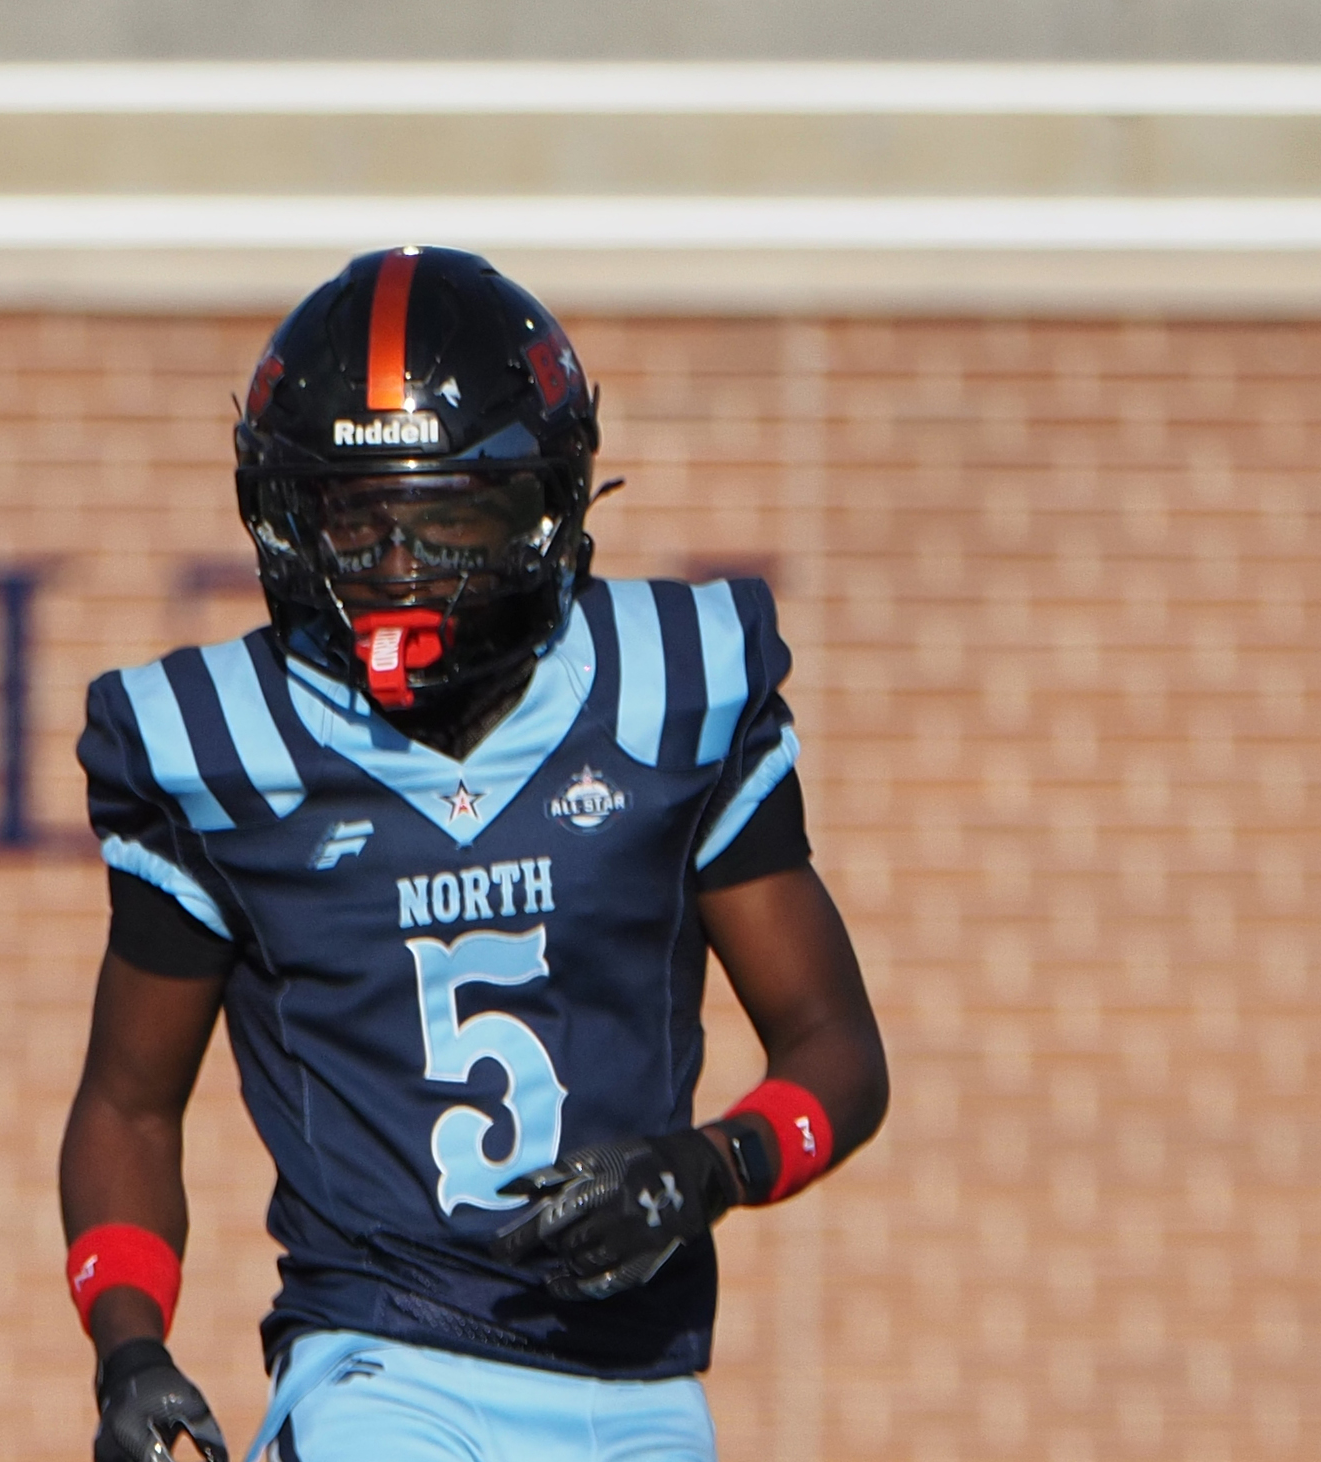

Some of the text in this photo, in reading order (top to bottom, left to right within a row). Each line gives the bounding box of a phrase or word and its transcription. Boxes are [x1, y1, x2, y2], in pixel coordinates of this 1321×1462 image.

[333, 418, 439, 446] Riddell
[582, 790, 625, 814] STAR
[396, 856, 556, 929] NORTH
[404, 922, 569, 1218] 5
